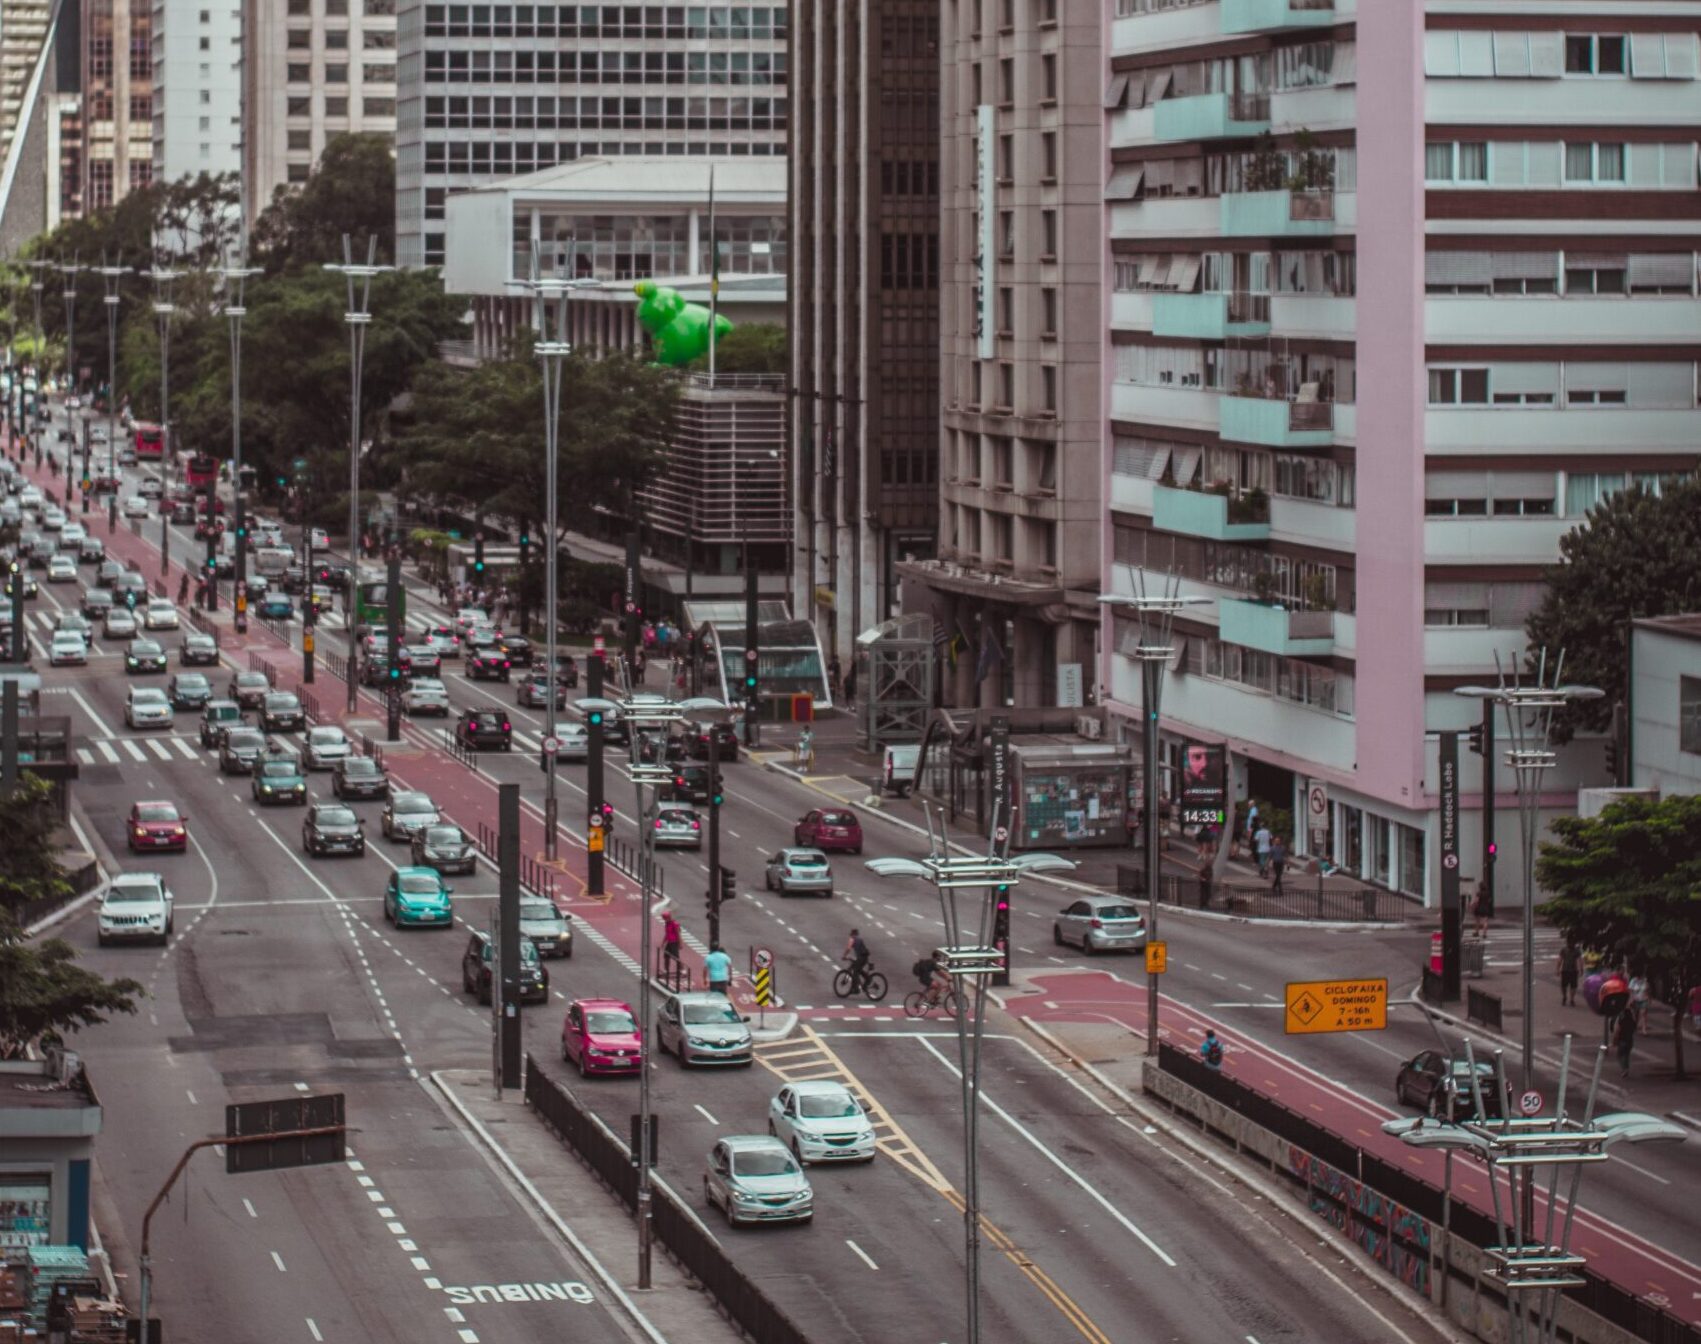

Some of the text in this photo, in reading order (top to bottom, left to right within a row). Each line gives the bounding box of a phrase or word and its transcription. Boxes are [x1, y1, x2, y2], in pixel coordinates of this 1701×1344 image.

[995, 744, 1005, 791] Augusta
[1444, 762, 1453, 789] Lobo
[1184, 810, 1217, 822] 14:33
[1444, 792, 1454, 839] Haddock
[1324, 984, 1384, 995] CICLOFAIXA
[1332, 995, 1377, 1005] DOMINGO
[1523, 1095, 1540, 1107] 50
[443, 1282, 595, 1304] ÔNIBUS
